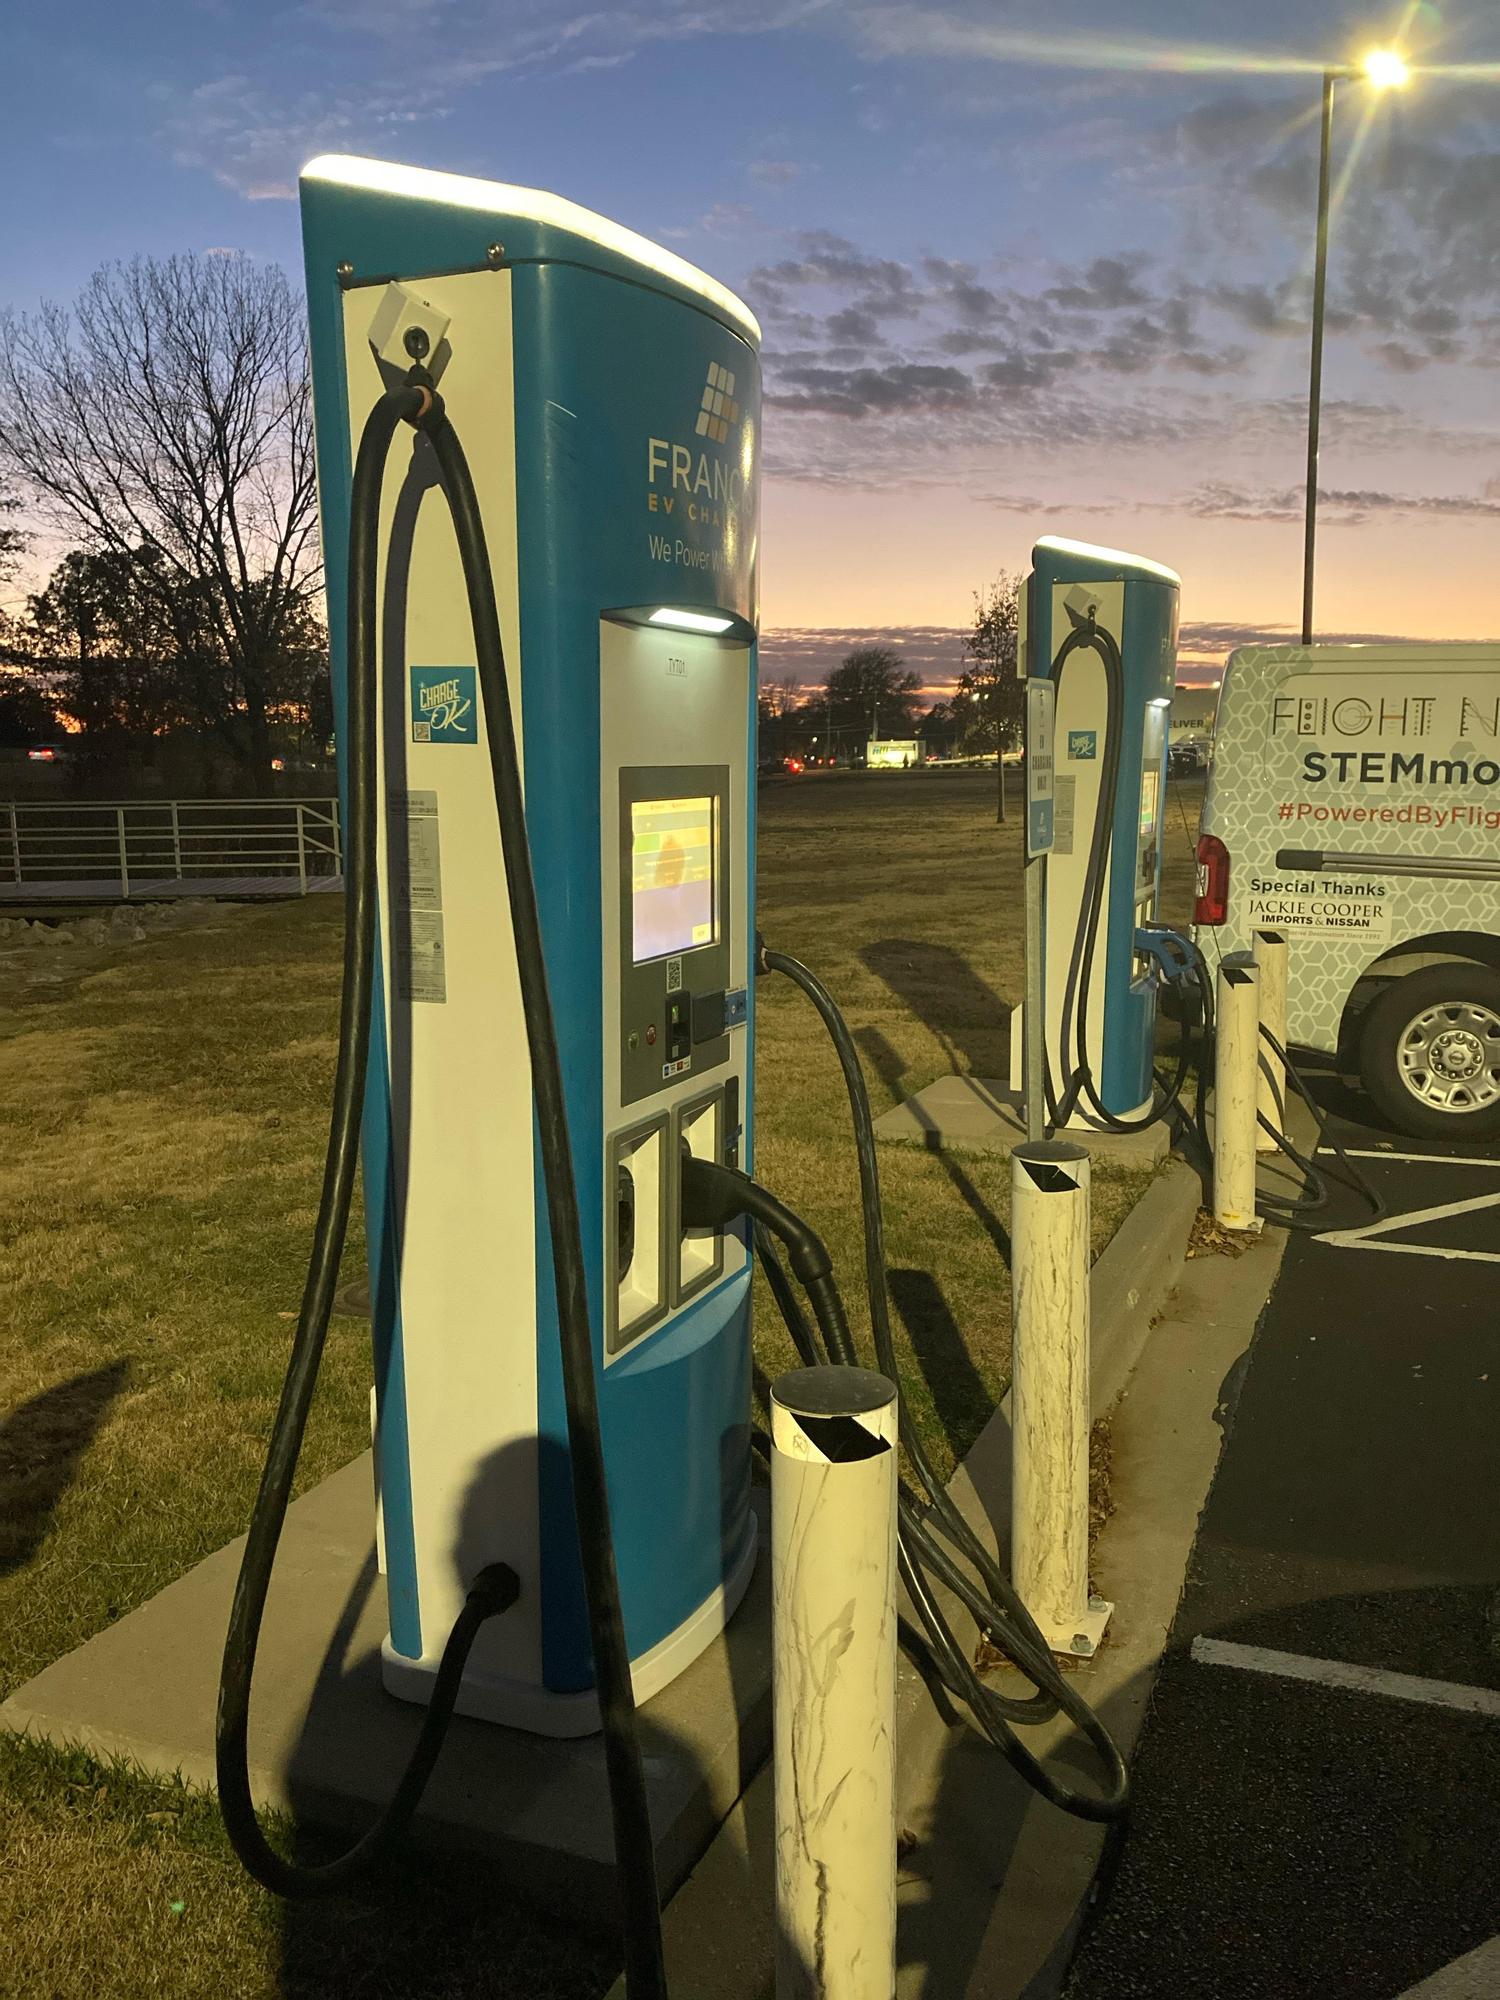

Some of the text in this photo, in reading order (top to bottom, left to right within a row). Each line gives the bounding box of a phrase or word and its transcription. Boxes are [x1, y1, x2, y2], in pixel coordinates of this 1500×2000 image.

[648, 493, 674, 514] EV
[649, 534, 672, 562] We
[675, 540, 710, 570] Power
[420, 679, 460, 708] CHARGE
[430, 699, 471, 732] OK
[1272, 697, 1437, 736] FLIGHT
[1302, 751, 1500, 785] STEMmo
[1278, 803, 1500, 829] #PoweredByFlig
[1250, 878, 1386, 896] Special Thanks
[1249, 900, 1384, 917] JACKIE COOPER
[1261, 914, 1370, 927] IMPORTS & NISSAN
